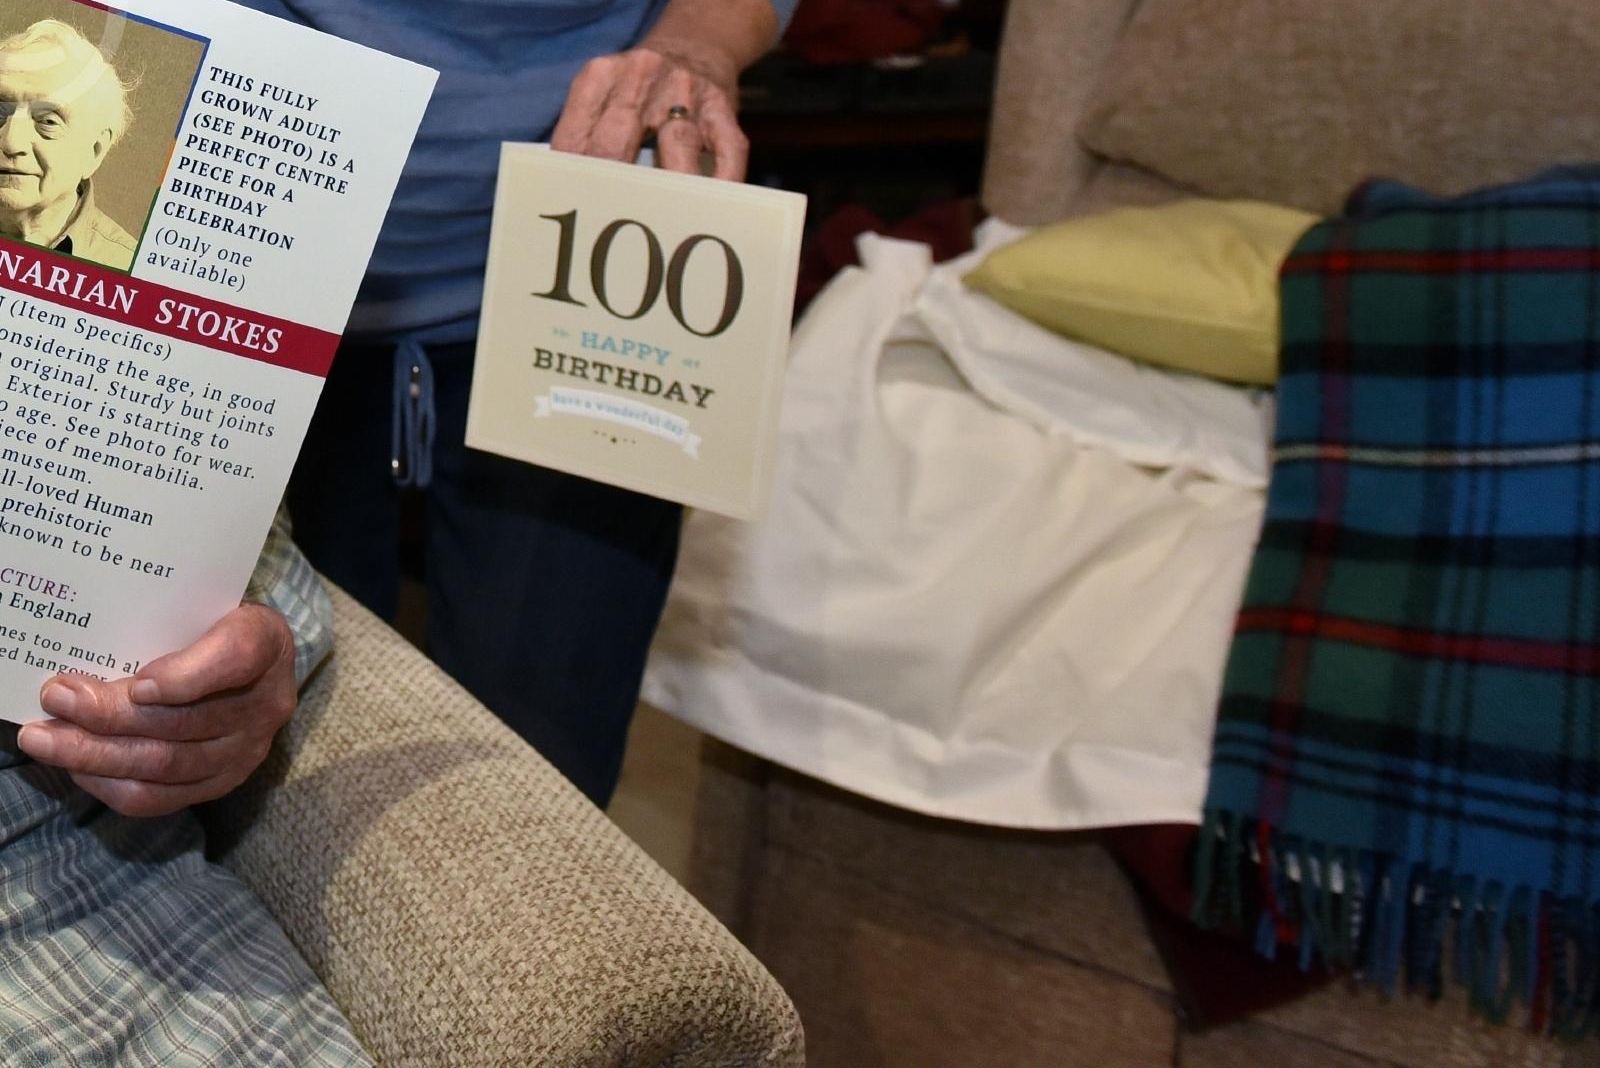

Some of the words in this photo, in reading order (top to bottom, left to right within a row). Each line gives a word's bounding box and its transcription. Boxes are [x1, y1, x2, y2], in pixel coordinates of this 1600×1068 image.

[209, 65, 255, 93] THIS
[258, 82, 319, 112] FULLY
[200, 89, 275, 124] GROWN
[276, 114, 342, 144] ADULT
[184, 132, 271, 171] PERFECT
[275, 161, 349, 195] CENTRE
[192, 112, 236, 136] (SEE
[239, 125, 313, 163] PHOTO)
[317, 149, 339, 168] IS
[341, 158, 354, 174] A
[168, 177, 269, 218] BIRTHDAY
[176, 155, 235, 185] PIECE
[237, 173, 276, 198] FOR
[280, 188, 294, 204] A
[155, 226, 212, 259] (Only
[217, 248, 253, 268] one
[163, 201, 295, 251] CELEBRATION
[146, 251, 246, 293] available)
[530, 208, 745, 338] 100
[9, 299, 67, 329] (Item
[73, 317, 172, 362] Specifics)
[154, 298, 283, 354] STOKES
[580, 331, 672, 367] HAPPY
[10, 356, 99, 393] original.
[106, 380, 175, 414] Sturdy
[180, 399, 215, 423] but
[217, 410, 275, 438] joints
[116, 359, 149, 382] the
[155, 374, 195, 399] age,
[201, 382, 222, 402] in
[227, 393, 276, 415] good
[532, 347, 716, 410] BIRTHDAY
[5, 374, 94, 413] Exterior
[98, 400, 117, 420] is
[122, 412, 205, 447] starting
[210, 432, 230, 450] to
[0, 448, 92, 485] museum.
[15, 405, 57, 428] age.
[65, 415, 101, 439] See
[106, 430, 166, 457] photo
[172, 445, 203, 466] for
[209, 457, 255, 479] wear.
[44, 436, 70, 453] of
[71, 444, 204, 491] memorabilia.
[0, 497, 112, 539] prehistoric
[82, 492, 154, 526] Human
[72, 539, 93, 557] to
[99, 544, 123, 566] be
[128, 558, 175, 578] near
[8, 591, 92, 629] England
[33, 633, 62, 652] too
[67, 646, 116, 669] much
